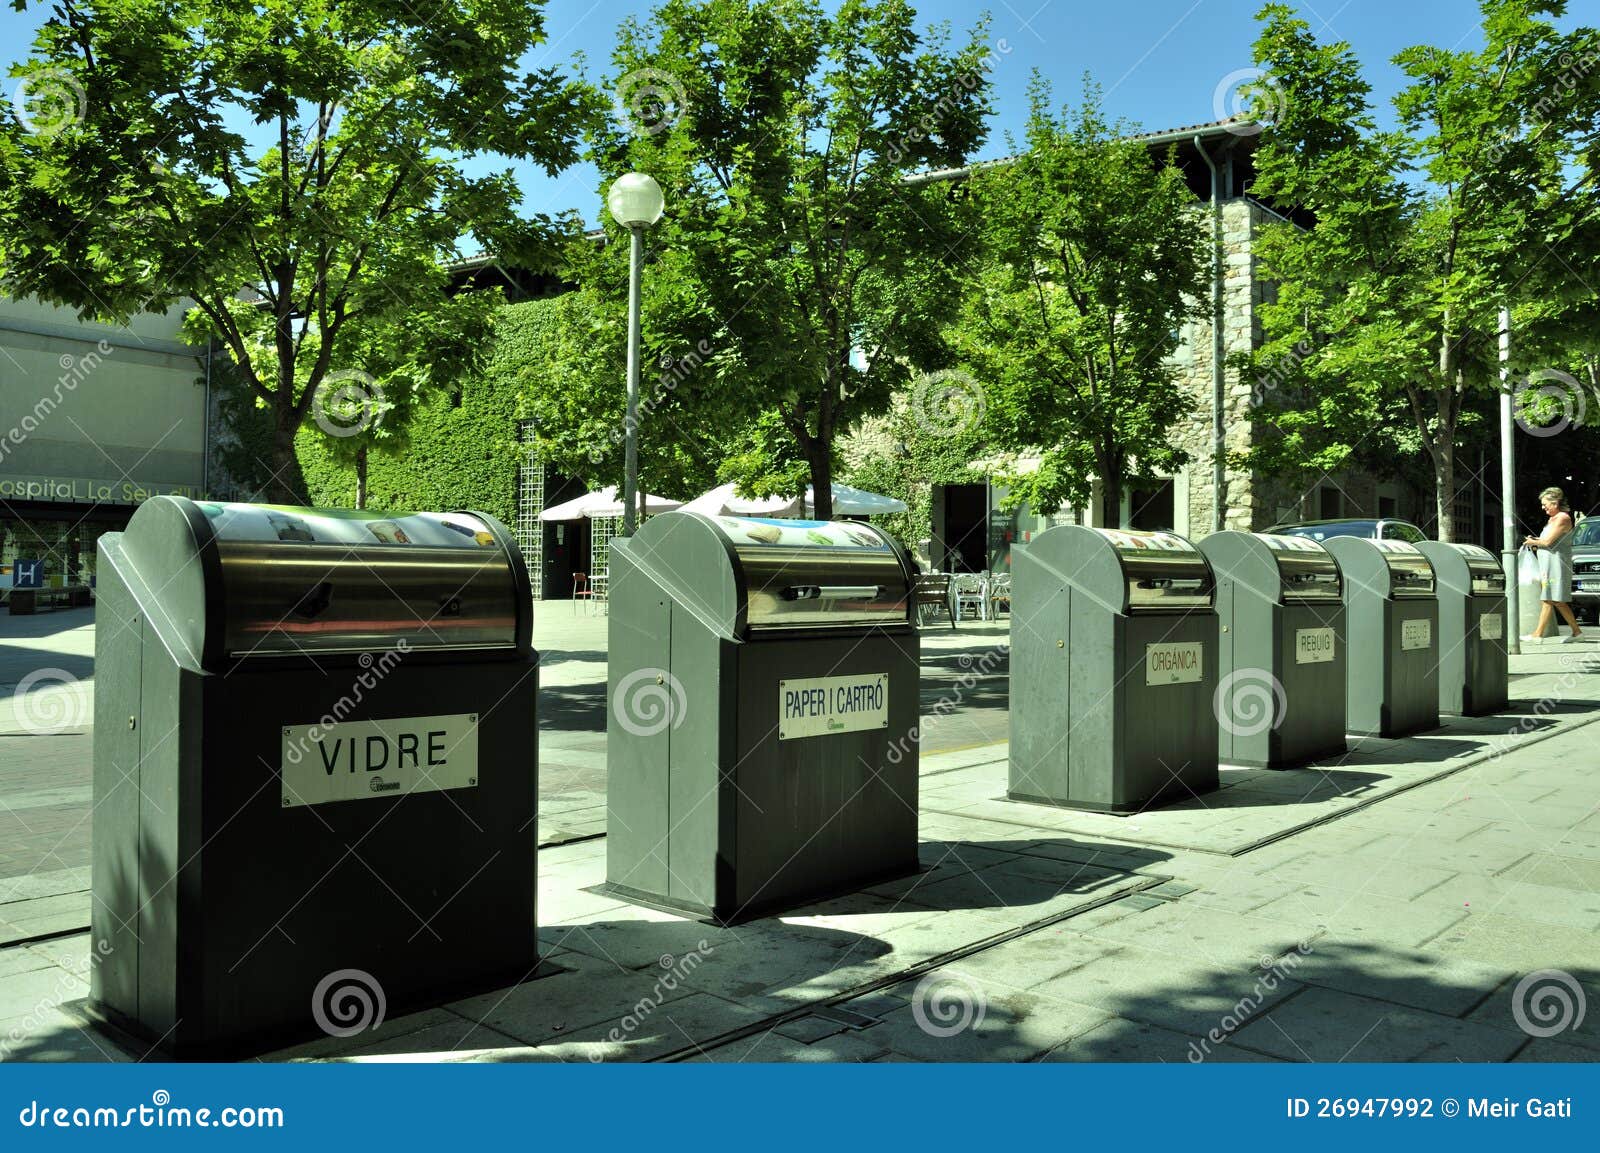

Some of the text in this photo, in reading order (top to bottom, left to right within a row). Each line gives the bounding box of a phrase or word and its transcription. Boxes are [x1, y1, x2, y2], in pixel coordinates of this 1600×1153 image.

[88, 481, 112, 500] La
[18, 564, 35, 584] H
[1301, 634, 1330, 652] REBUIG
[785, 678, 883, 719] PAPER I CARTRÓ
[318, 730, 447, 776] VIDRE
